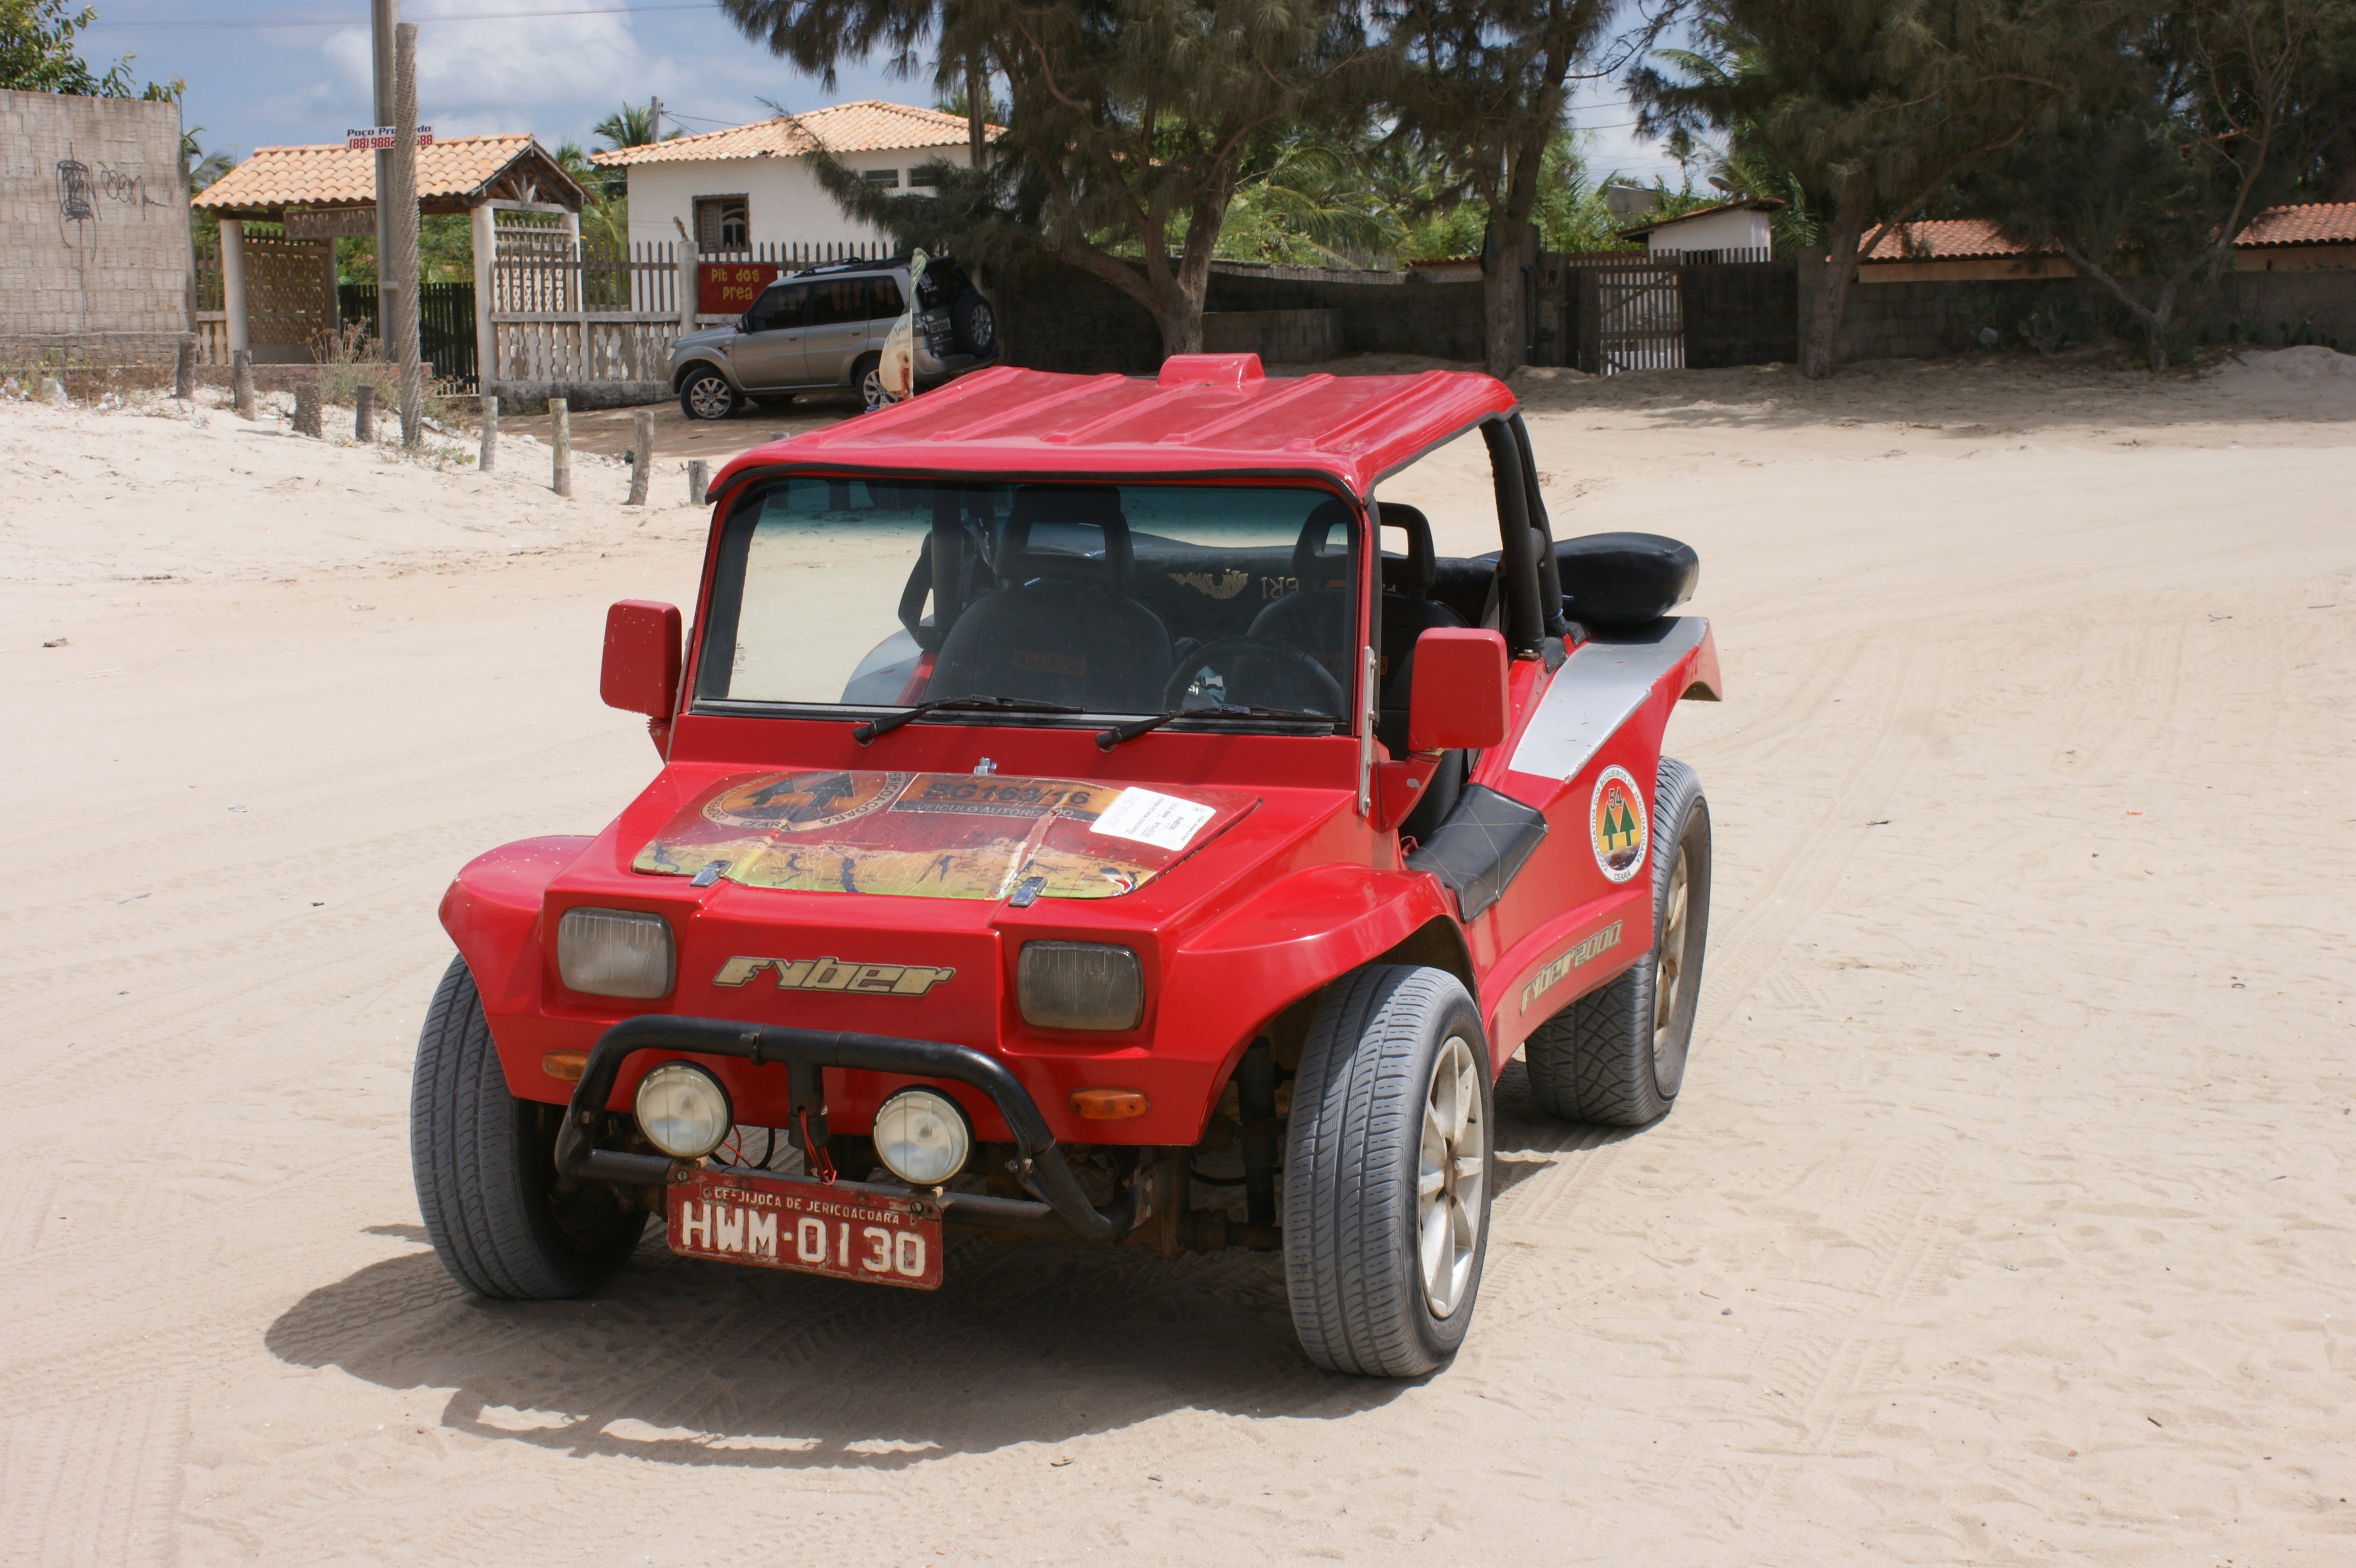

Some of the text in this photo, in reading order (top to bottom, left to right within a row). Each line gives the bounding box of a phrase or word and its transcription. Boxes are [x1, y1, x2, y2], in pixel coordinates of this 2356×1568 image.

[711, 268, 728, 282] Pit
[1599, 770, 1627, 787] BUGUEIROS
[1627, 779, 1635, 789] DE
[1608, 787, 1623, 810] 54
[1634, 792, 1646, 864] JERICOACOARA
[1592, 809, 1608, 872] COOPERATIVA
[1614, 869, 1632, 881] CEARÁ
[786, 1197, 802, 1211] DE
[806, 1199, 900, 1226] JERICOACOARA
[681, 1200, 926, 1277] HWM-0130
